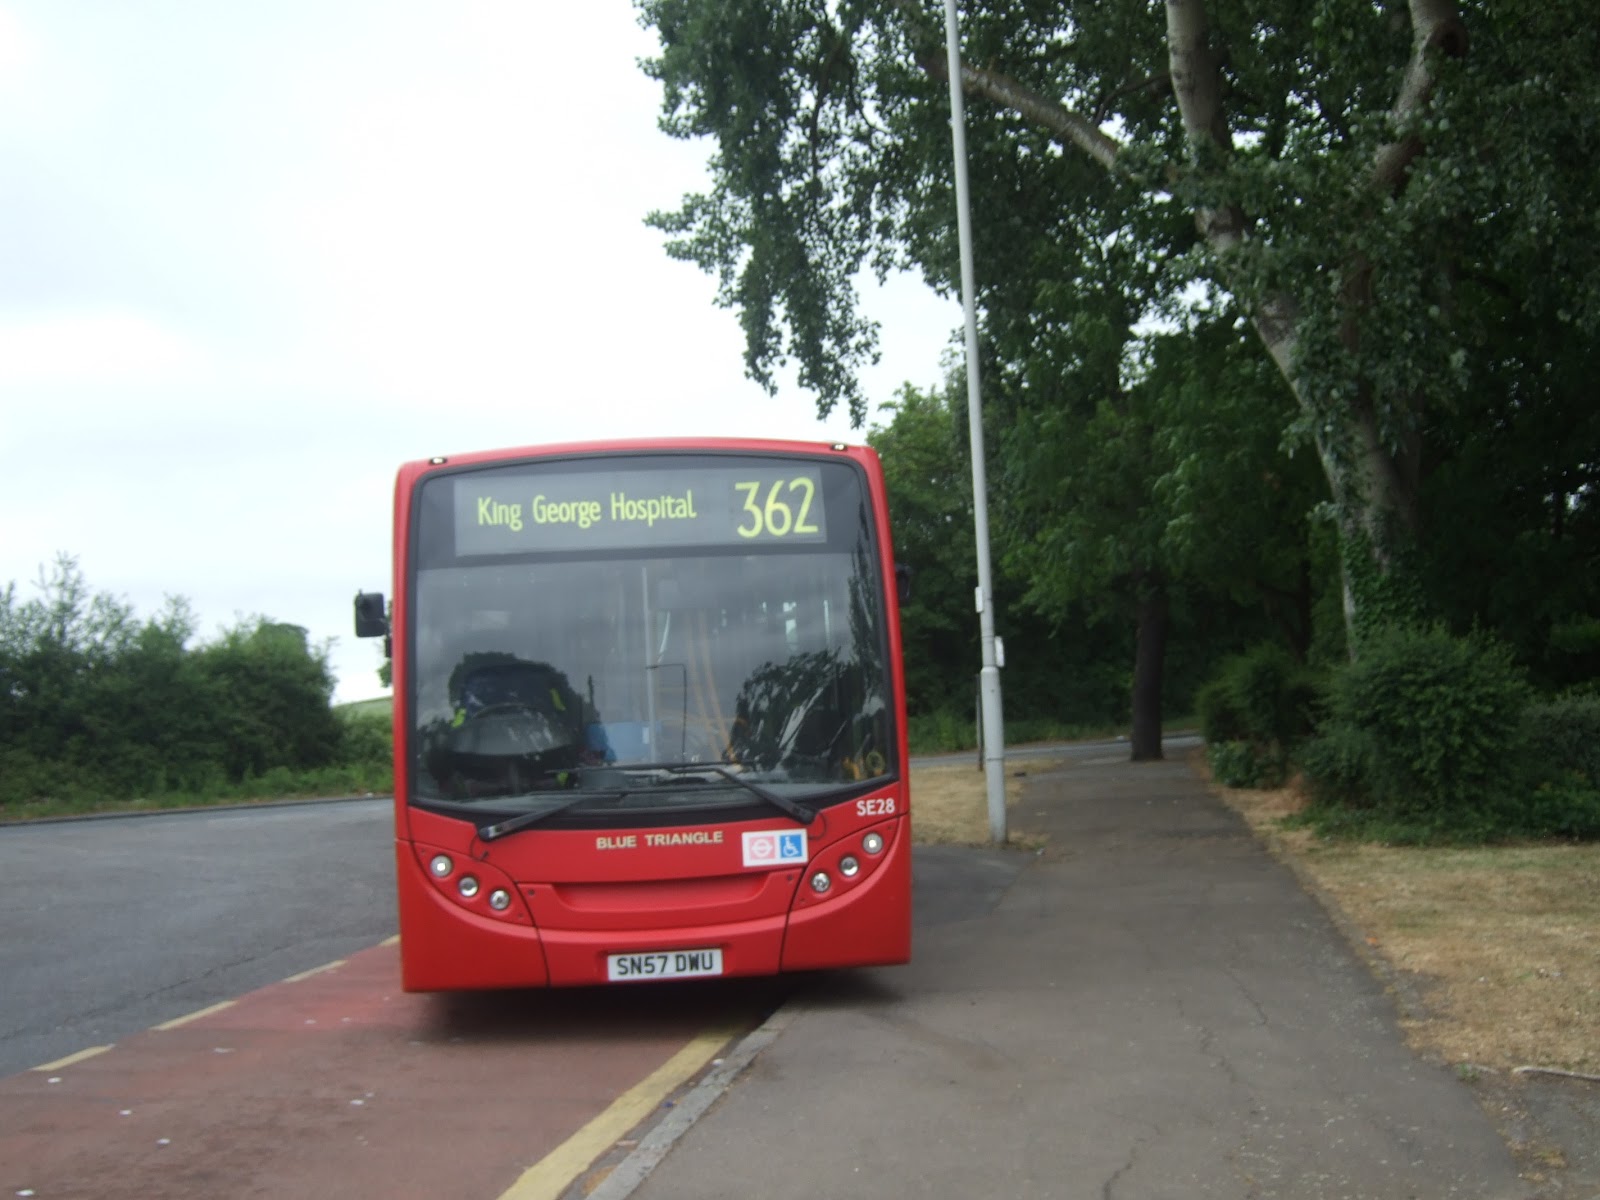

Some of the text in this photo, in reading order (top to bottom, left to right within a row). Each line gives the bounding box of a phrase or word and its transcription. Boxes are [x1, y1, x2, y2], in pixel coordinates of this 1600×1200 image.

[477, 490, 697, 532] King George Hospital
[735, 477, 819, 538] 362
[856, 798, 896, 817] SE28
[596, 831, 724, 849] BLUE TRIANGLE
[616, 952, 713, 977] SN57 DWU
